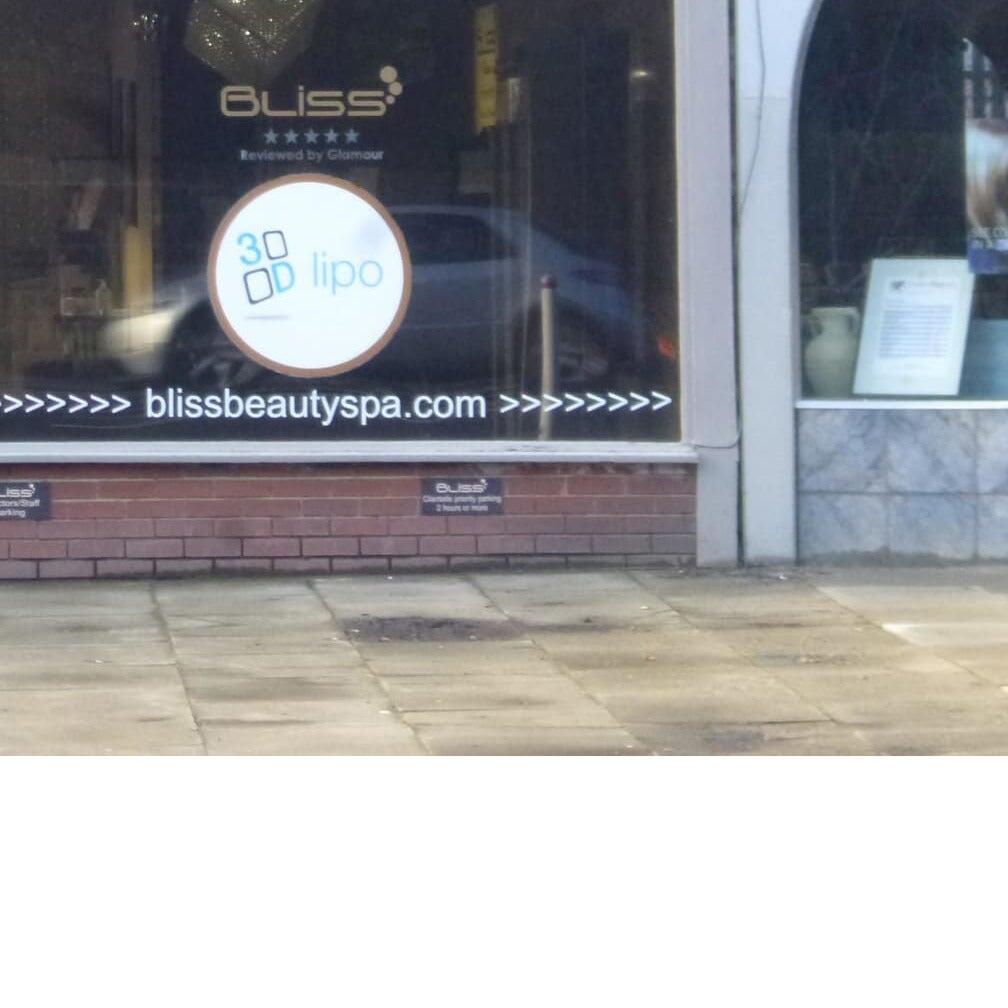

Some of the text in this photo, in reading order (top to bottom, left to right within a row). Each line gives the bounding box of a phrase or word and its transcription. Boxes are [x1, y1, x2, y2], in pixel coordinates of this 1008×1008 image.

[306, 149, 323, 163] by
[312, 251, 384, 296] lipo
[145, 387, 487, 426] blissbeautyspa.com
